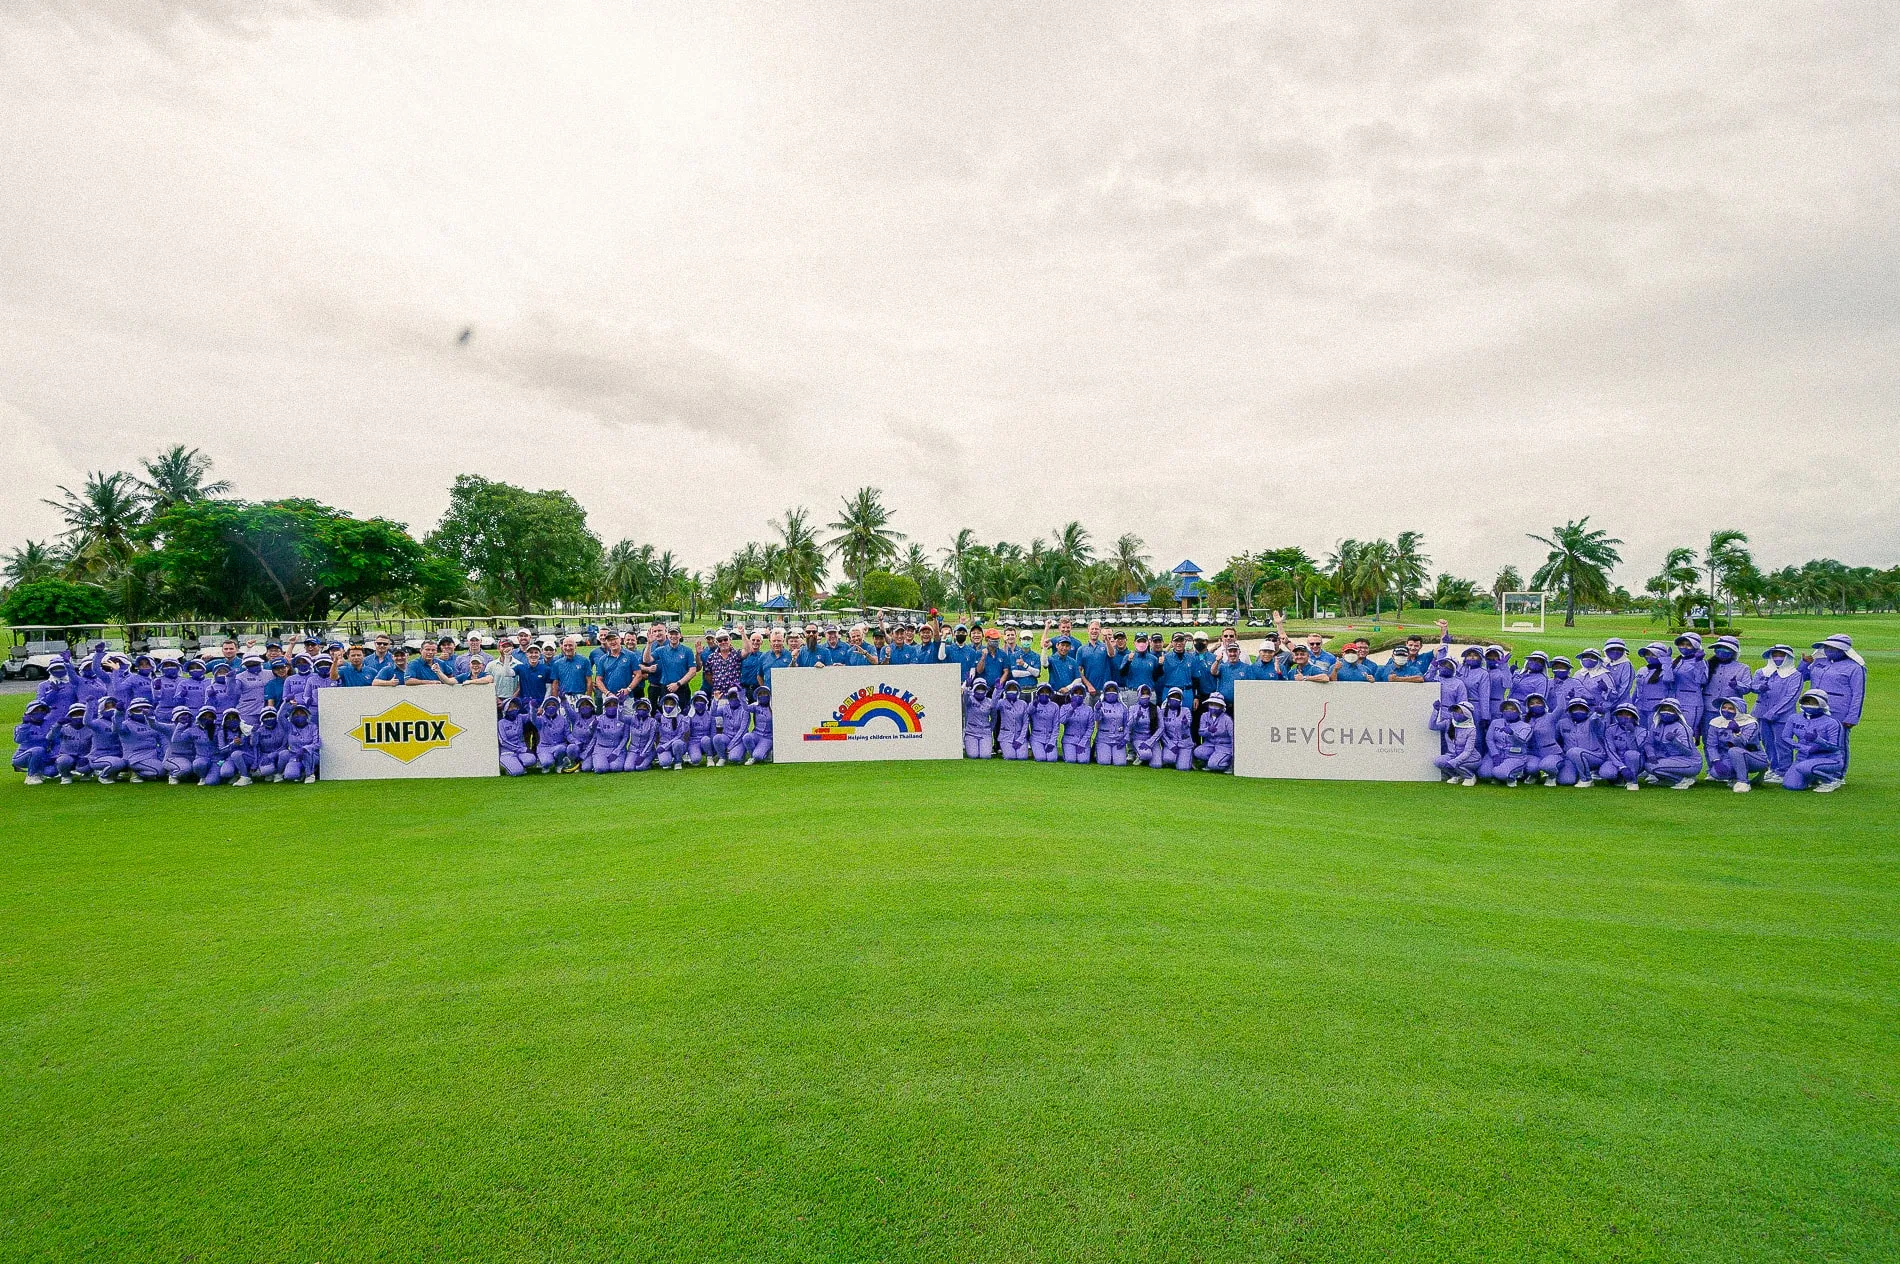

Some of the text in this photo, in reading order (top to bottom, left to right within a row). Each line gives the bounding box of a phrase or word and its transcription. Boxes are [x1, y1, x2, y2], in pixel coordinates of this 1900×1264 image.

[833, 683, 925, 720] Convoy for Kids
[365, 720, 445, 743] LINFOX
